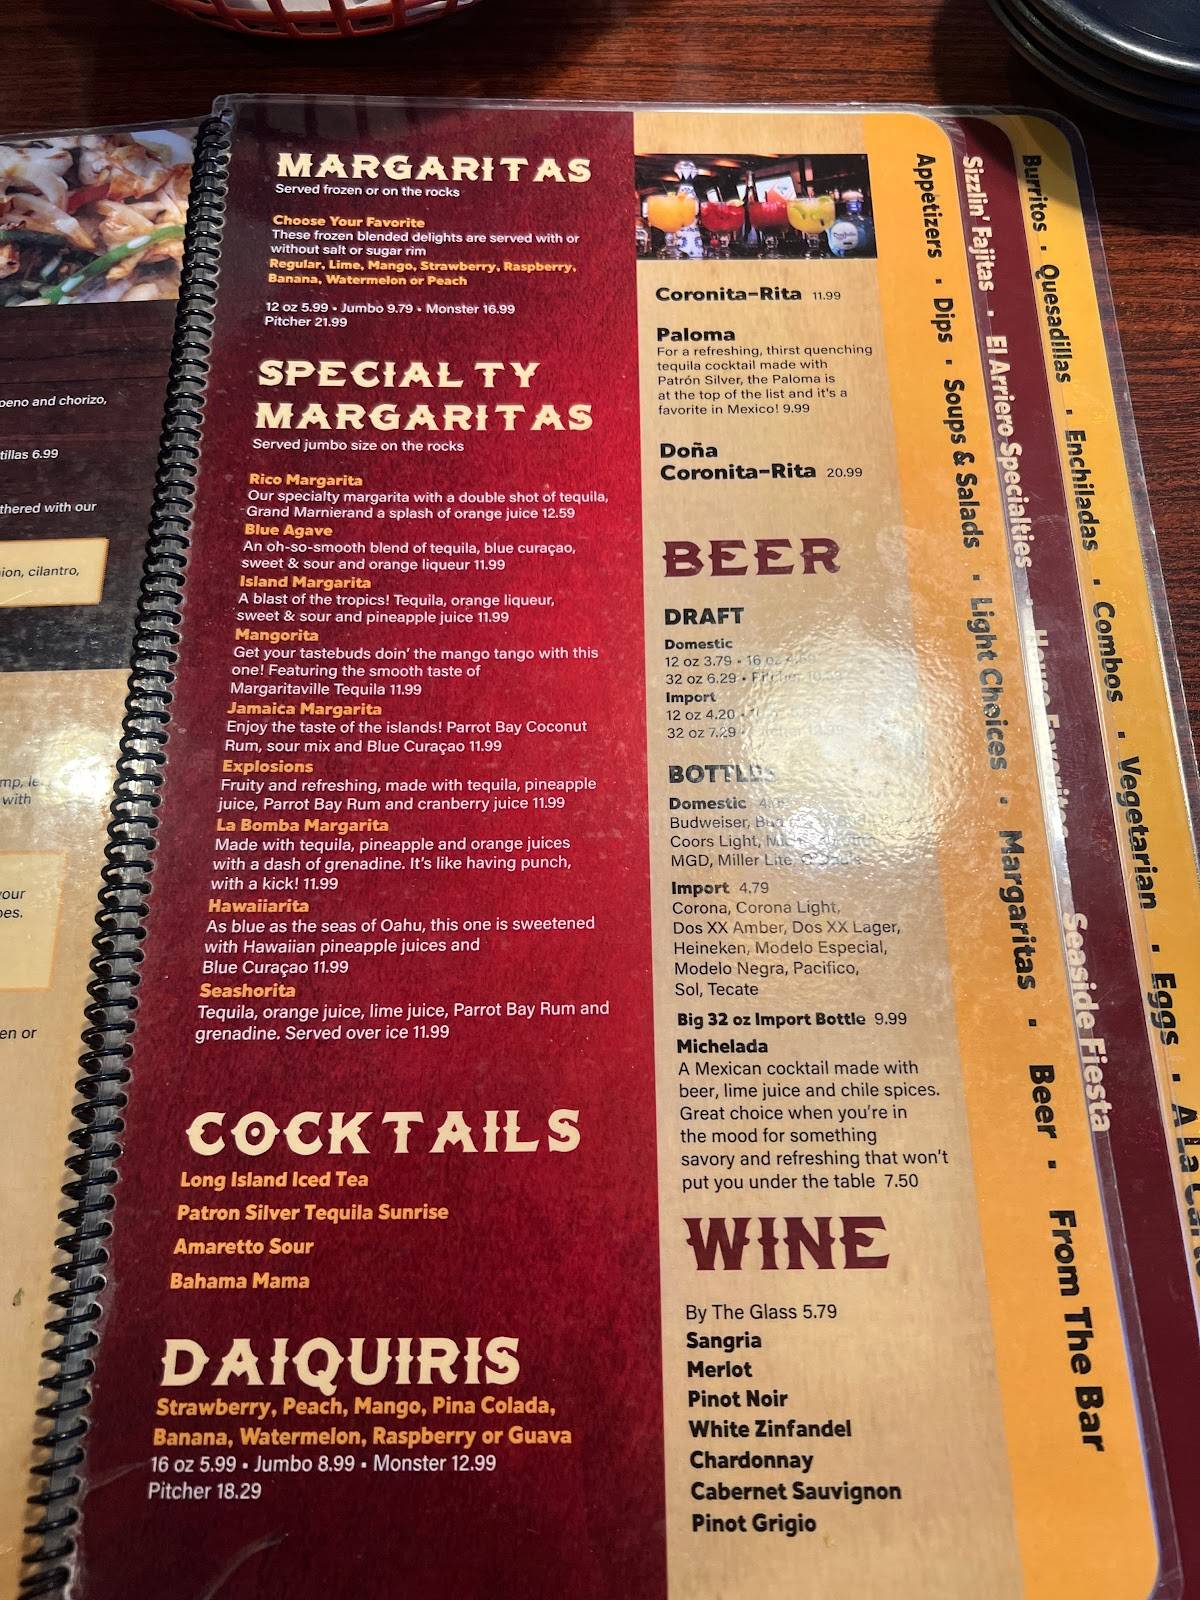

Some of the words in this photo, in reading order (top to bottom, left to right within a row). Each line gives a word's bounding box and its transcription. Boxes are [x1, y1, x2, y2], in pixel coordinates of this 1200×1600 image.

[277, 152, 592, 183] MARGARITAS
[275, 183, 320, 194] Served
[322, 184, 362, 195] frozen
[365, 187, 379, 195] or
[382, 187, 398, 195] on
[401, 186, 422, 196] the
[425, 186, 459, 197] rocks
[1023, 155, 1049, 232] Burritos
[913, 153, 943, 259] Appetizers
[272, 214, 325, 226] Choose
[329, 215, 363, 226] Your
[366, 216, 425, 227] Favorite
[968, 226, 996, 292] Fajitas
[813, 291, 840, 300] 11.99
[266, 302, 279, 311] 12
[300, 302, 328, 312] 5.99
[340, 303, 384, 313] Jumbo
[387, 303, 413, 313] 9.79
[426, 303, 479, 314] Monster
[482, 304, 515, 314] 16.99
[264, 315, 311, 326] Pitcher
[314, 317, 347, 327] 21.99
[930, 298, 956, 344] Dips
[1034, 264, 1072, 384] Quesadillas
[657, 327, 735, 341] Paloma
[657, 347, 678, 356] For
[682, 348, 689, 356] a
[694, 345, 762, 357] refreshing,
[766, 345, 799, 354] thirst
[804, 344, 872, 356] quenching
[985, 335, 1008, 354] El
[31, 395, 56, 406] and
[58, 394, 106, 405] chorizo,
[988, 359, 1016, 437] Arriero
[255, 403, 593, 432] MARGARITAS
[943, 379, 966, 444] Soups
[31, 448, 58, 458] 6.99
[660, 442, 717, 458] Doña
[249, 473, 282, 484] Rico
[286, 473, 362, 488] Margarita
[827, 467, 862, 477] 20.99
[1065, 430, 1099, 551] Enchiladas
[44, 501, 71, 512] with
[74, 503, 97, 511] our
[956, 473, 984, 548] Salads
[997, 442, 1035, 568] Specialties
[244, 523, 279, 535] Blue
[283, 524, 332, 539] Agave
[662, 538, 841, 578] BEER
[28, 565, 79, 576] cilantro,
[240, 575, 288, 587] Island
[292, 576, 371, 591] Margarita
[664, 607, 744, 625] DRAFT
[235, 627, 319, 643] Mangorita
[967, 597, 998, 662] Light
[664, 638, 732, 649] Domestic
[1092, 601, 1124, 703] Combos
[666, 692, 716, 705] Import
[227, 701, 295, 714] Jamaica
[300, 702, 381, 718] Margarita
[979, 668, 1008, 771] Choices
[222, 759, 313, 775] Explosions
[669, 797, 746, 809] Domestic
[216, 818, 235, 831] La
[240, 818, 299, 831] Bomba
[304, 818, 388, 835] Margarita
[1116, 755, 1158, 910] Vegetarian
[671, 881, 730, 898] Import
[739, 881, 768, 893] 4.79
[208, 898, 309, 912] Hawaiiarita
[999, 830, 1037, 990] Margaritas
[202, 959, 237, 974] Blue
[242, 959, 308, 977] Curaçao
[313, 960, 348, 973] 11.99
[1063, 912, 1100, 1030] Seaside
[199, 982, 295, 997] Seashorita
[675, 982, 702, 997] Sol,
[707, 982, 758, 995] Tecate
[1147, 973, 1179, 1046] Eggs
[677, 1012, 703, 1029] Big
[707, 1012, 728, 1025] 32
[732, 1015, 751, 1025] oz
[755, 1012, 811, 1028] Import
[815, 1012, 865, 1025] Bottle
[874, 1012, 906, 1025] 9.99
[21, 1029, 37, 1038] or
[677, 1038, 767, 1053] Michelada
[1078, 1038, 1113, 1132] Fiesta
[1029, 1064, 1058, 1139] Beer
[1171, 1103, 1198, 1127] A
[185, 1108, 581, 1157] COCKTAILS
[180, 1171, 225, 1191] Long
[231, 1171, 287, 1187] Island
[292, 1171, 331, 1187] Iced
[335, 1171, 368, 1186] Tea
[177, 1204, 240, 1220] Patron
[244, 1203, 300, 1220] Silver
[304, 1203, 373, 1224] Tequila
[378, 1203, 448, 1219] Sunrise
[173, 1238, 264, 1254] Amaretto
[268, 1237, 314, 1254] Sour
[682, 1216, 890, 1271] WINE
[1049, 1210, 1080, 1297] From
[170, 1272, 247, 1288] Bahama
[252, 1272, 309, 1288] Mama
[686, 1304, 707, 1324] By
[711, 1303, 744, 1319] The
[749, 1303, 797, 1319] Glass
[803, 1304, 836, 1318] 5.79
[686, 1331, 761, 1352] Sangria
[1064, 1306, 1094, 1375] The
[160, 1336, 521, 1396] DAIQUIRIS
[687, 1360, 752, 1377] Merlot
[688, 1389, 741, 1407] Pinot
[746, 1389, 788, 1407] Noir
[156, 1397, 276, 1420] Strawberry,
[283, 1397, 348, 1417] Peach,
[354, 1396, 426, 1419] Mango,
[432, 1395, 475, 1414] Pina
[481, 1395, 555, 1416] Colada,
[688, 1419, 749, 1437] White
[754, 1419, 851, 1437] Zinfandel
[1075, 1386, 1105, 1452] Bar
[153, 1428, 233, 1448] Banana,
[239, 1427, 366, 1447] Watermelon,
[372, 1426, 476, 1449] Raspberry
[481, 1430, 503, 1444] or
[508, 1425, 571, 1443] Guava
[151, 1456, 168, 1472] 16
[174, 1459, 194, 1472] oz
[199, 1456, 236, 1472] 5.99
[254, 1454, 312, 1472] Jumbo
[317, 1455, 355, 1472] 8.99
[373, 1454, 446, 1471] Monster
[451, 1454, 496, 1471] 12.99
[689, 1450, 813, 1473] Chardonnay
[148, 1481, 211, 1499] Pitcher
[217, 1482, 261, 1499] 18.29
[691, 1481, 787, 1500] Cabernet
[792, 1480, 901, 1505] Sauvignon
[692, 1513, 747, 1532] Pinot
[751, 1513, 816, 1537] Grigio
